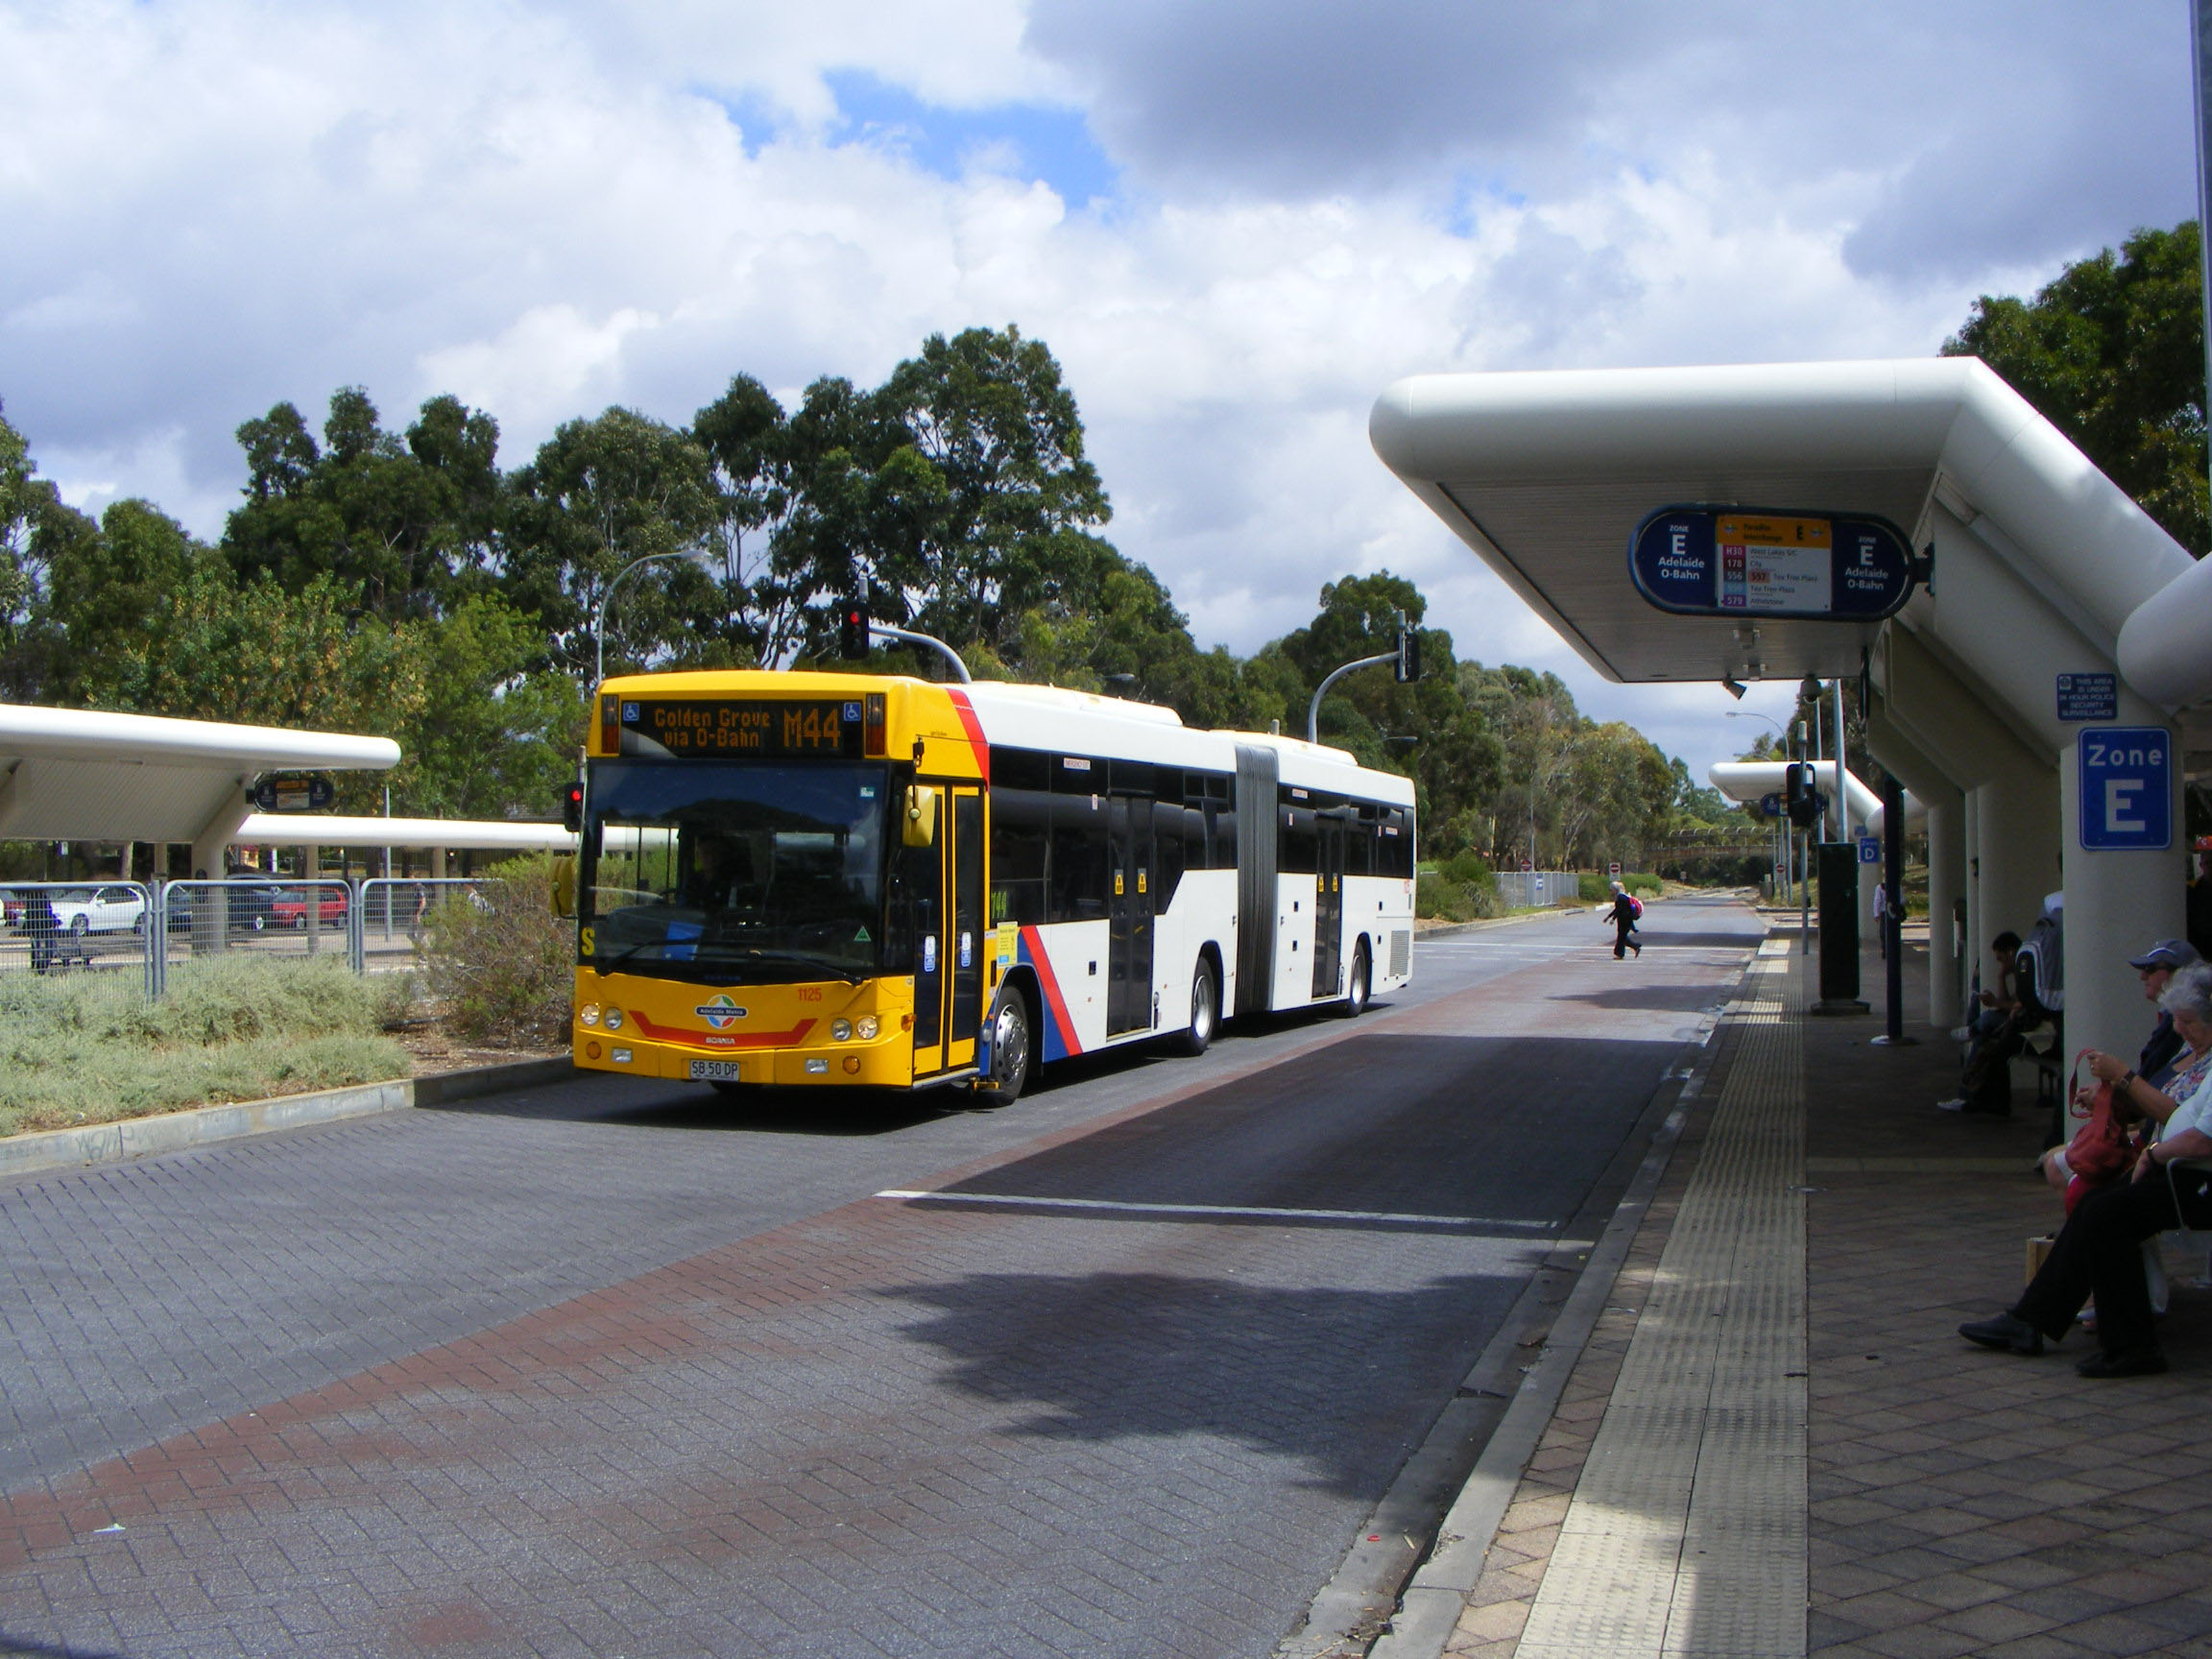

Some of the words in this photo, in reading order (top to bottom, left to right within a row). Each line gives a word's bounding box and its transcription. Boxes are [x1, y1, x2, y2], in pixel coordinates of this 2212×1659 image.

[1796, 525, 1804, 541] E
[1672, 534, 1686, 555] E
[1658, 556, 1705, 568] Adelaide
[1727, 559, 1743, 568] 178
[1861, 545, 1874, 566] E
[1661, 568, 1700, 580] O-Bahn
[1844, 567, 1888, 579] Adelaide
[1847, 579, 1885, 590] O-Bahn
[655, 708, 711, 728] Golden
[719, 708, 770, 728] Grove
[783, 708, 841, 747] M44
[664, 729, 688, 747] via
[696, 728, 759, 747] O-Bahn
[2087, 744, 2163, 767] Zone
[2105, 779, 2146, 832] E
[1864, 847, 1874, 860] D
[581, 926, 595, 956] S
[799, 988, 822, 1002] 1125
